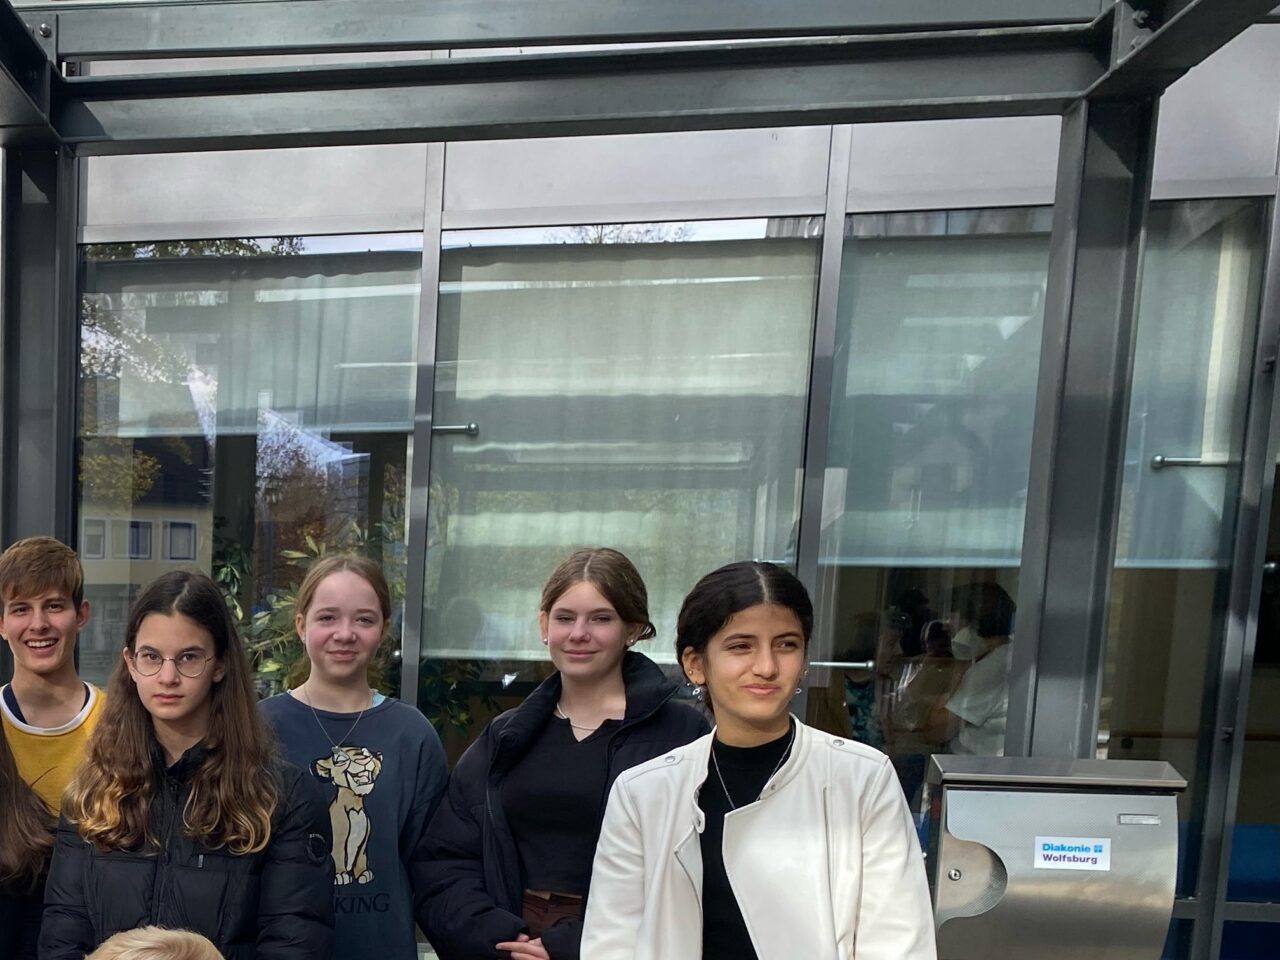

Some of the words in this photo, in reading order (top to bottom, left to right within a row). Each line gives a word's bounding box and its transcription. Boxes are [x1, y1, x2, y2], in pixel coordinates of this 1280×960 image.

[1042, 843, 1091, 853] Diakonie
[1042, 854, 1098, 865] Wolfsburg
[335, 893, 390, 914] KING
